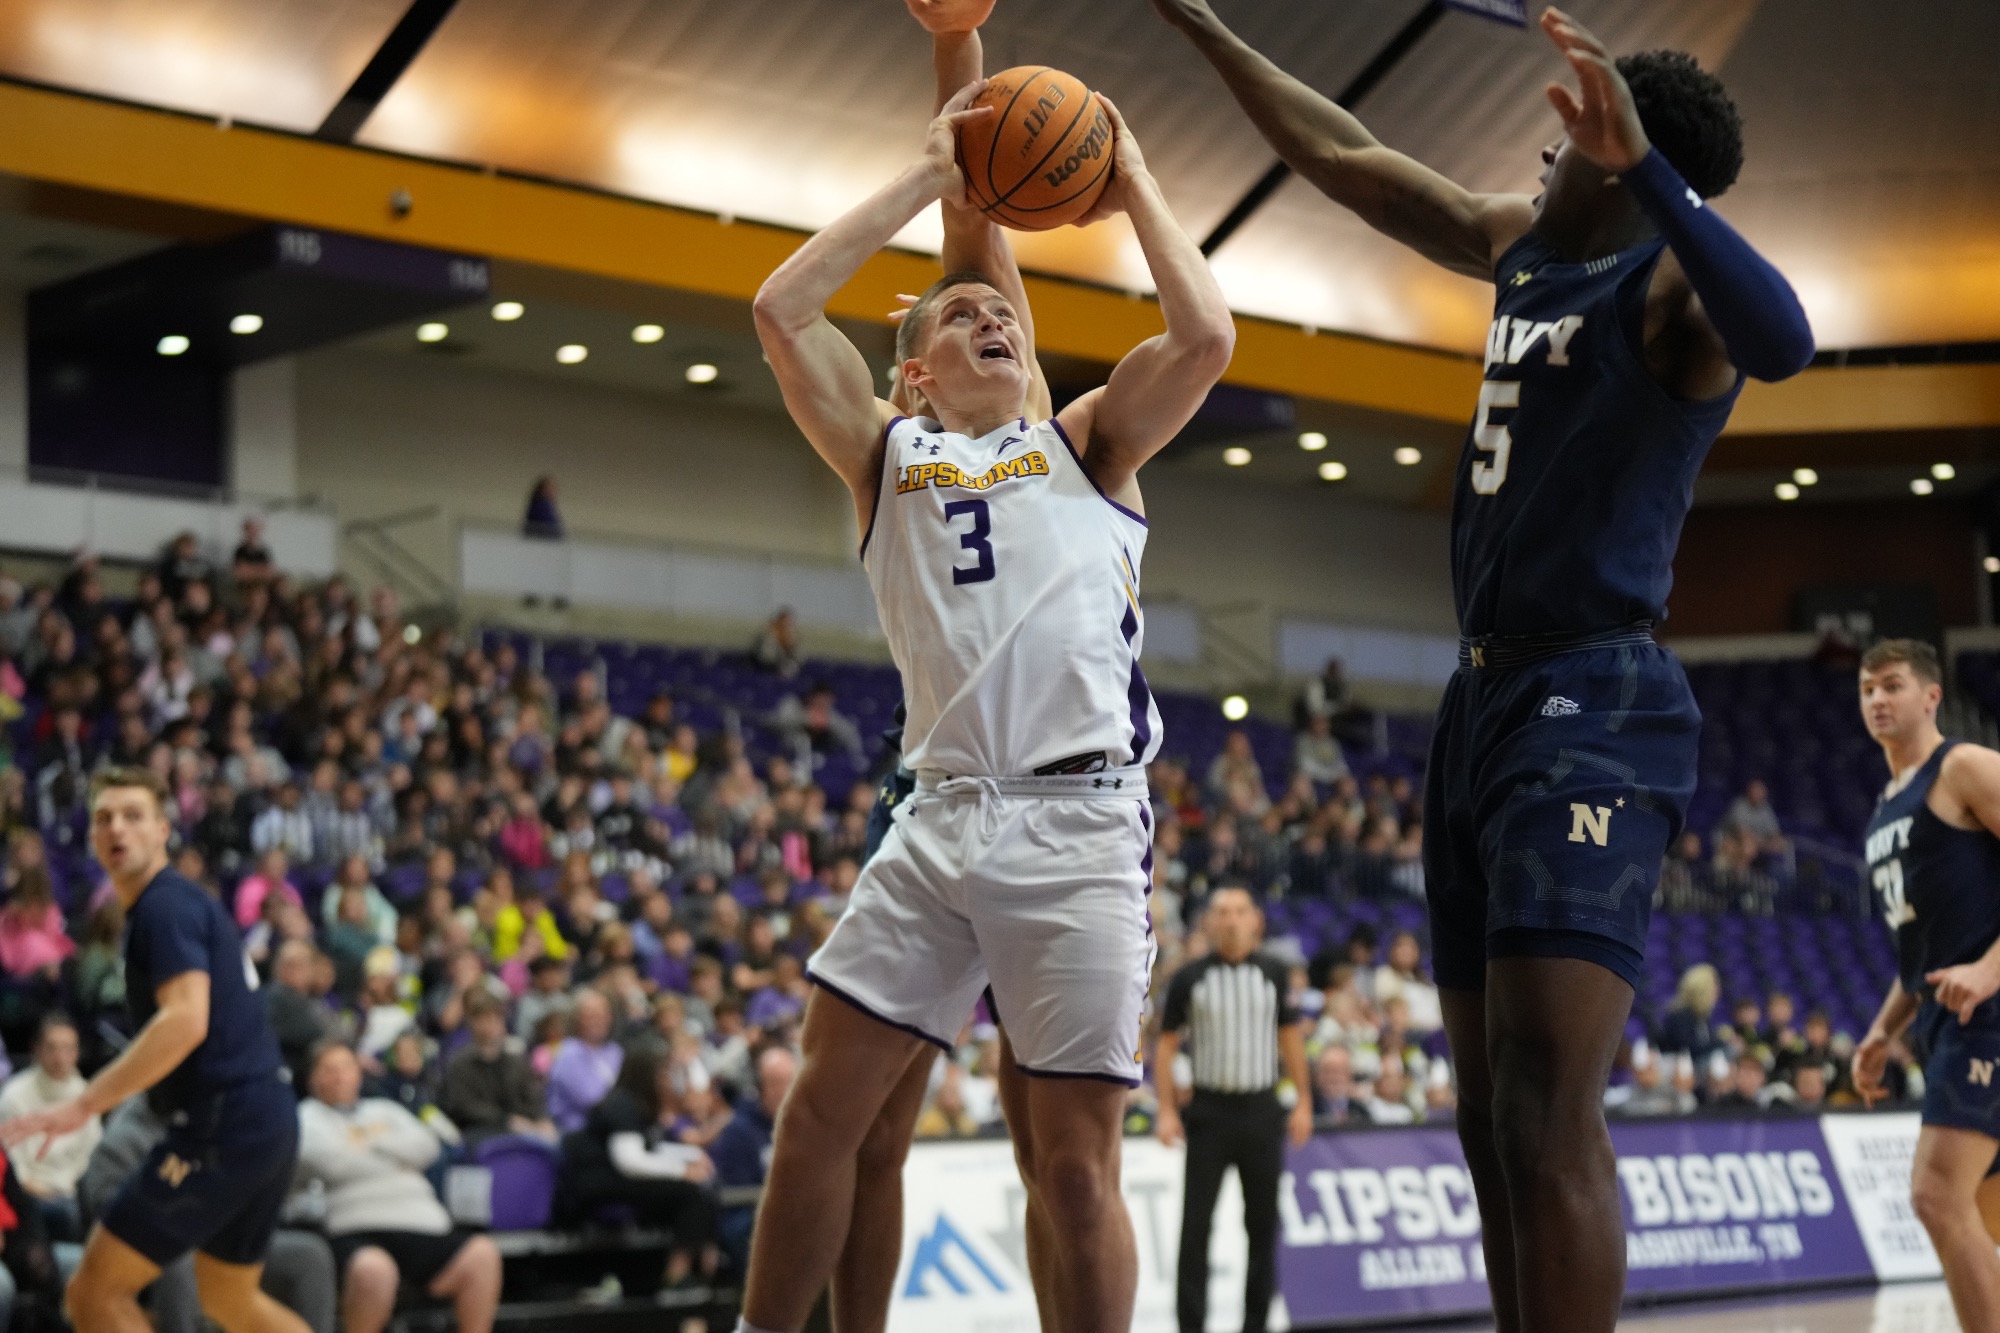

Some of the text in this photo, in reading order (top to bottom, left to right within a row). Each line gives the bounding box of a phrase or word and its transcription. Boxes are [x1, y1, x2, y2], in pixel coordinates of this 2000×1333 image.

[1044, 105, 1112, 187] Wilson
[1471, 380, 1521, 495] 5
[896, 451, 1050, 495] LIPSCOMB
[945, 499, 996, 585] 3
[1568, 802, 1612, 847] N
[1967, 1057, 1995, 1088] N
[1276, 1163, 1482, 1246] LIPSC
[1616, 1149, 1835, 1227] BISONS
[1358, 1244, 1467, 1291] ALLEN
[1626, 1225, 1766, 1270] ASHVILLE,
